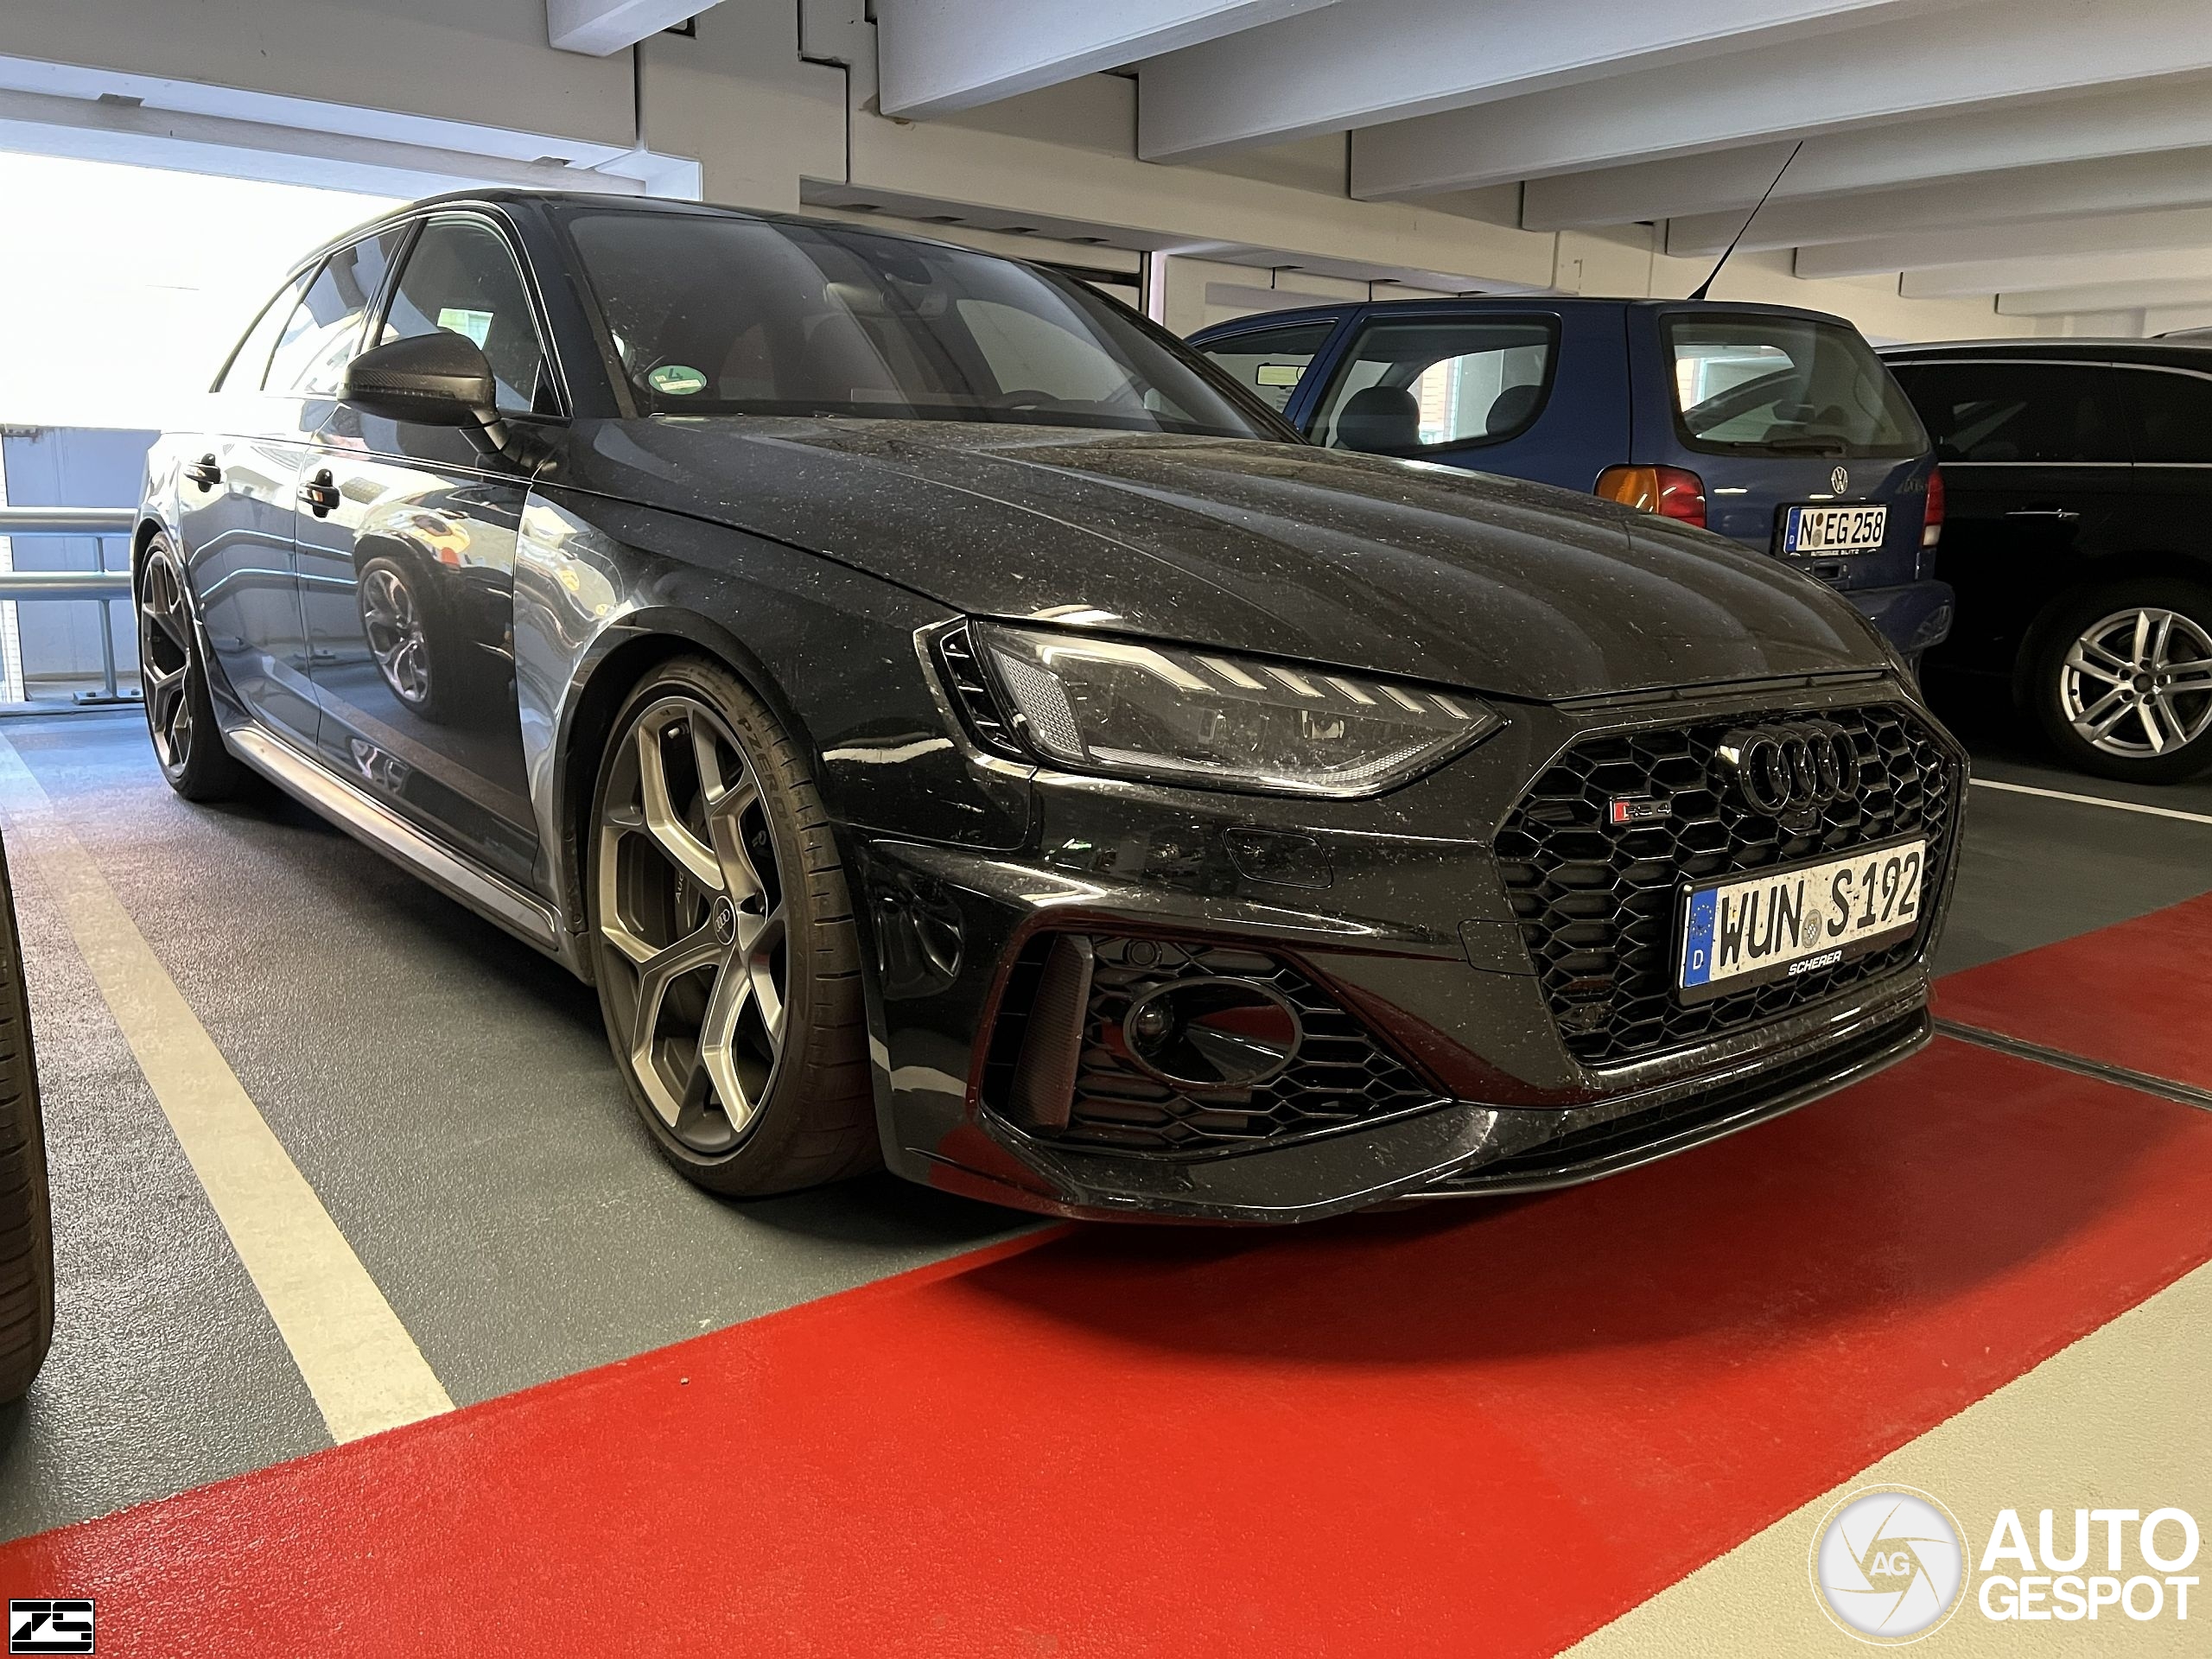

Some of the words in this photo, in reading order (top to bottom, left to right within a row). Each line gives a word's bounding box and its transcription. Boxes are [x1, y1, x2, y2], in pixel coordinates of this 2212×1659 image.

[1799, 512, 1815, 546] N
[1851, 511, 1884, 543] 258
[1693, 949, 1704, 970] D
[1719, 880, 1805, 968] WUN
[1827, 868, 1853, 938] S
[1857, 851, 1921, 930] 192
[1787, 949, 1843, 977] SCHERER
